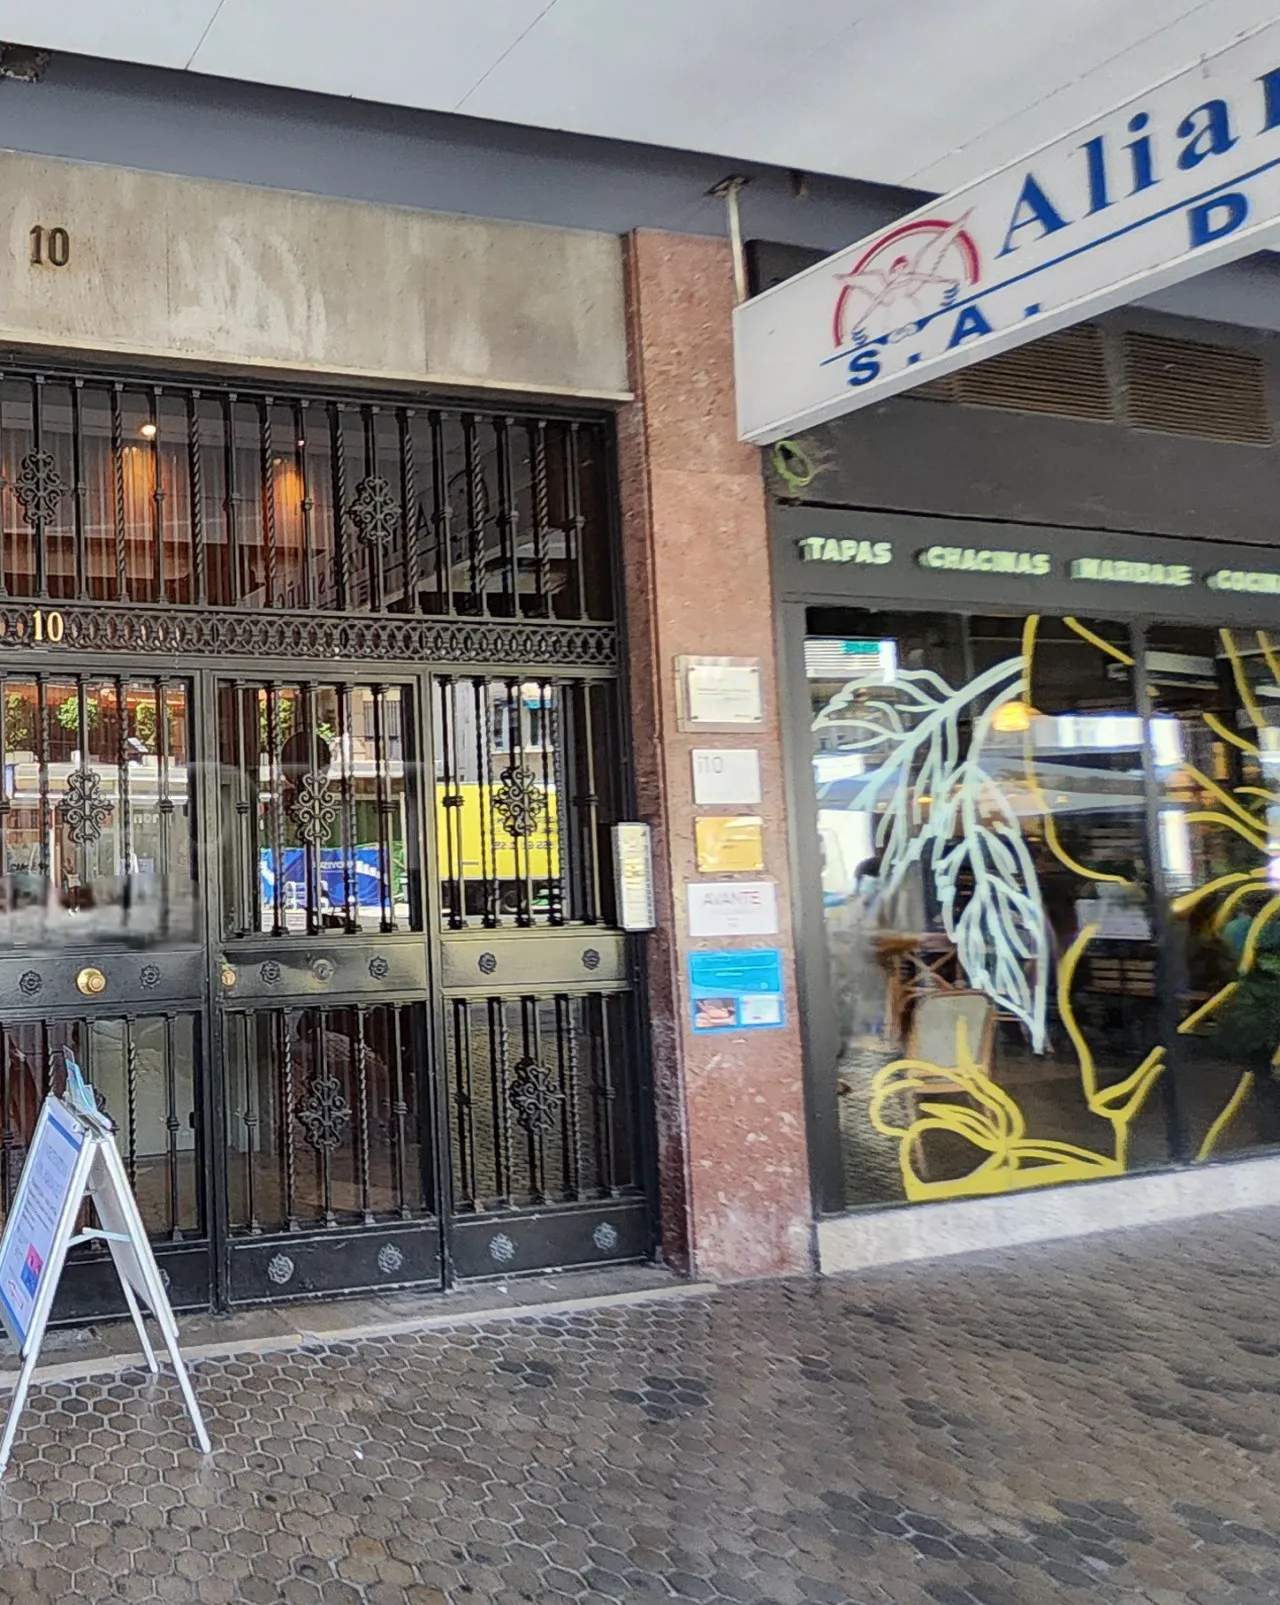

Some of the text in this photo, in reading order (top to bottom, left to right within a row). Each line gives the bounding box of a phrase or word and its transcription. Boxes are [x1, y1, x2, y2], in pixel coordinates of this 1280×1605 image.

[29, 224, 70, 267] 10
[800, 536, 892, 565] TAPAS
[32, 609, 64, 642] 10
